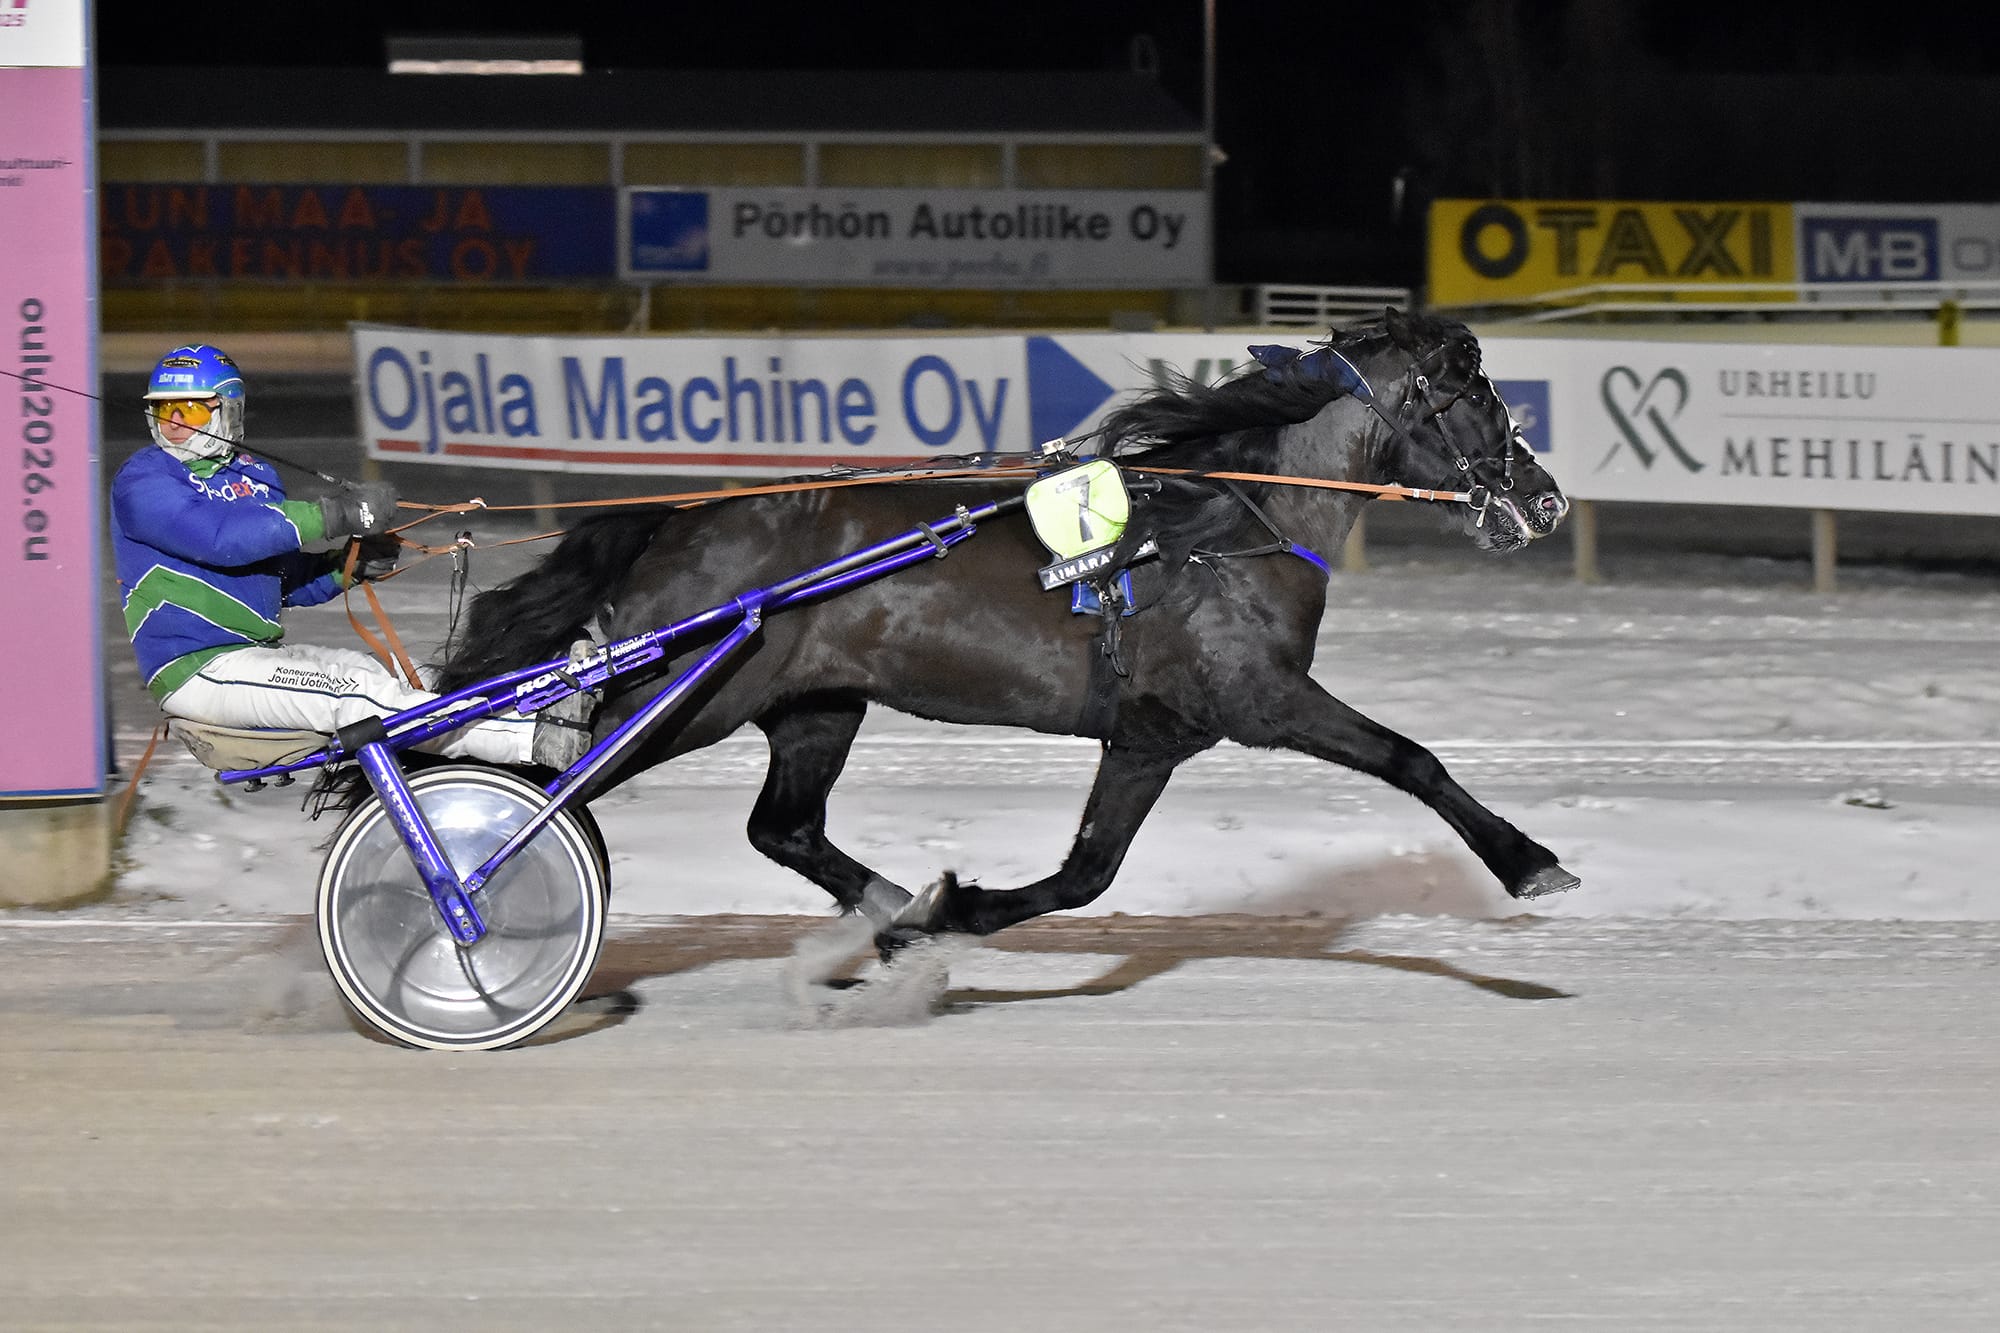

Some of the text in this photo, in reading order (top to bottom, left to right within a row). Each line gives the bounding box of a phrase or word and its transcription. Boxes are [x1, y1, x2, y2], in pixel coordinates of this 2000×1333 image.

[421, 189, 493, 231] JA
[732, 200, 1186, 248] Pörhön Autoliike Oy
[451, 237, 535, 281] OY
[367, 346, 1010, 466] Ojala Machine Oy
[1718, 368, 1878, 401] URHEILU
[20, 298, 55, 561] oulu2026.eu
[1055, 474, 1094, 543] 7
[267, 674, 300, 686] Jouni
